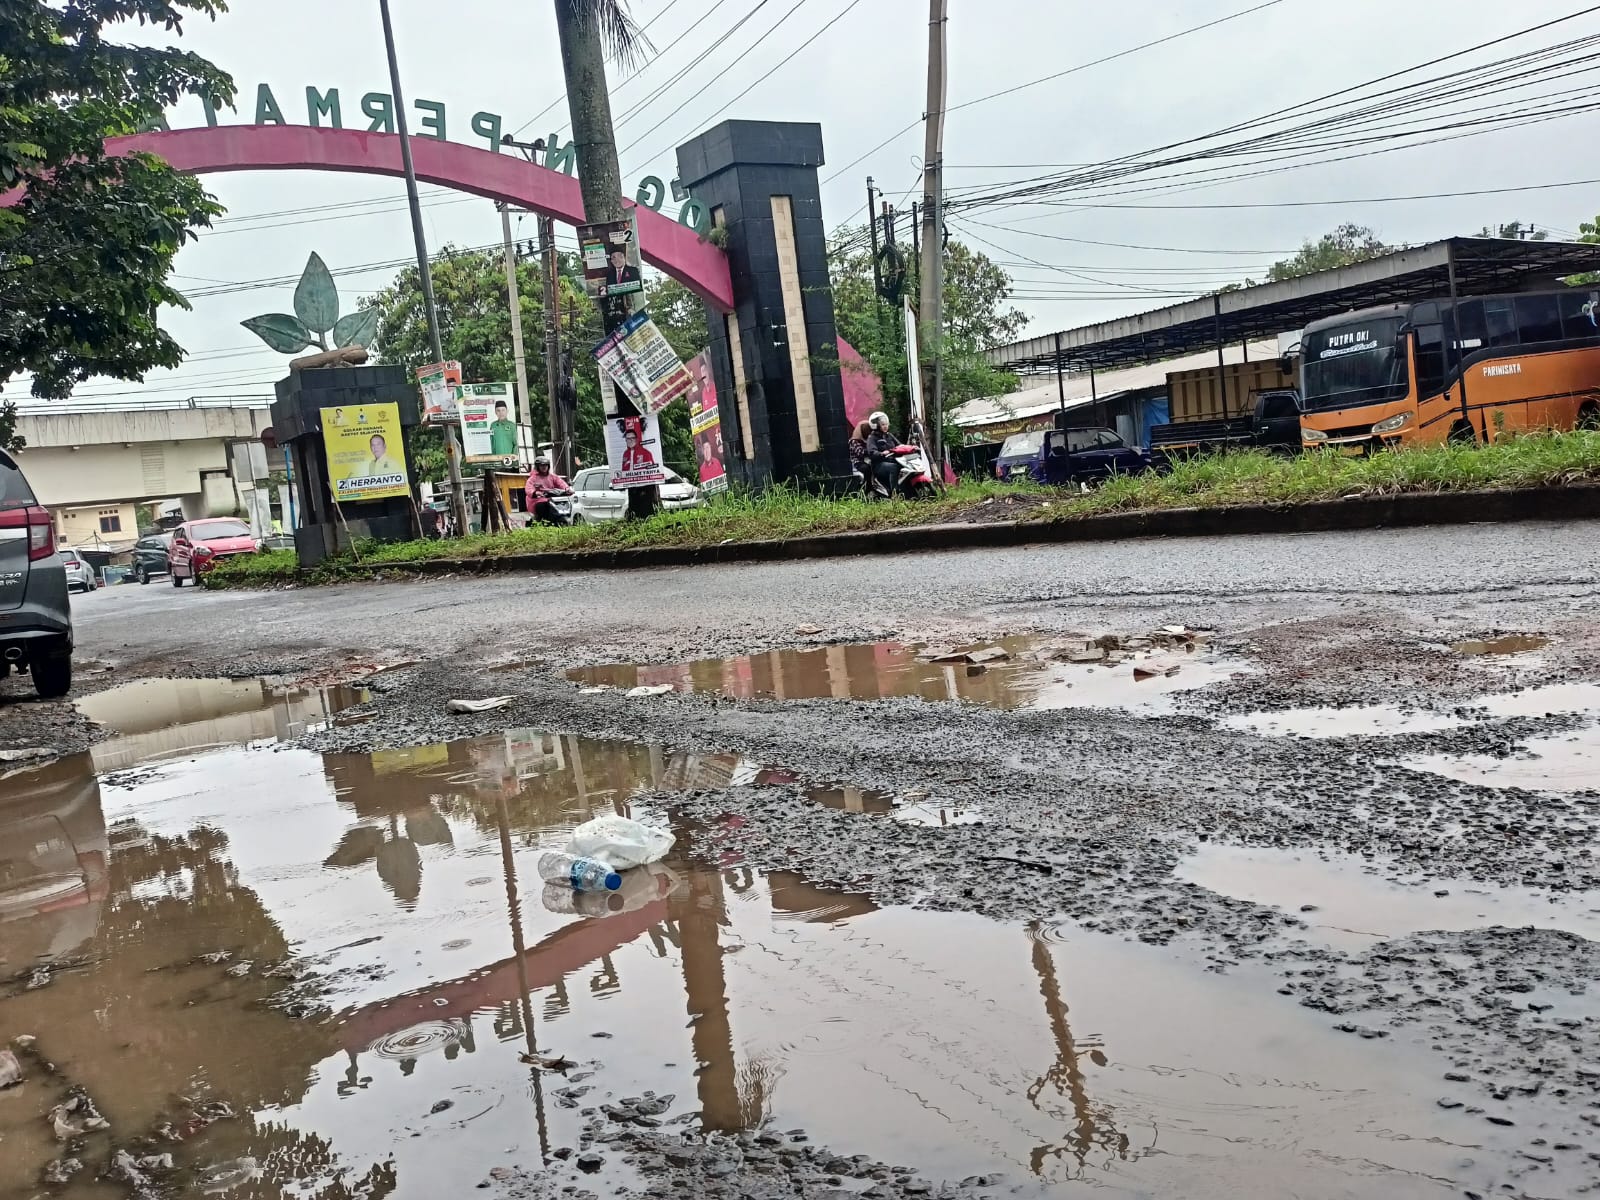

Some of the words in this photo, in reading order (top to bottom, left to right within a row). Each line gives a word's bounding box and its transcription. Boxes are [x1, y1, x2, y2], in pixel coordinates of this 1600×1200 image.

[623, 229, 633, 242] 2
[1328, 332, 1354, 348] PUTRA
[1356, 329, 1370, 342] OKI
[1482, 363, 1522, 377] PARIWISATA
[350, 475, 402, 487] HERPANTO
